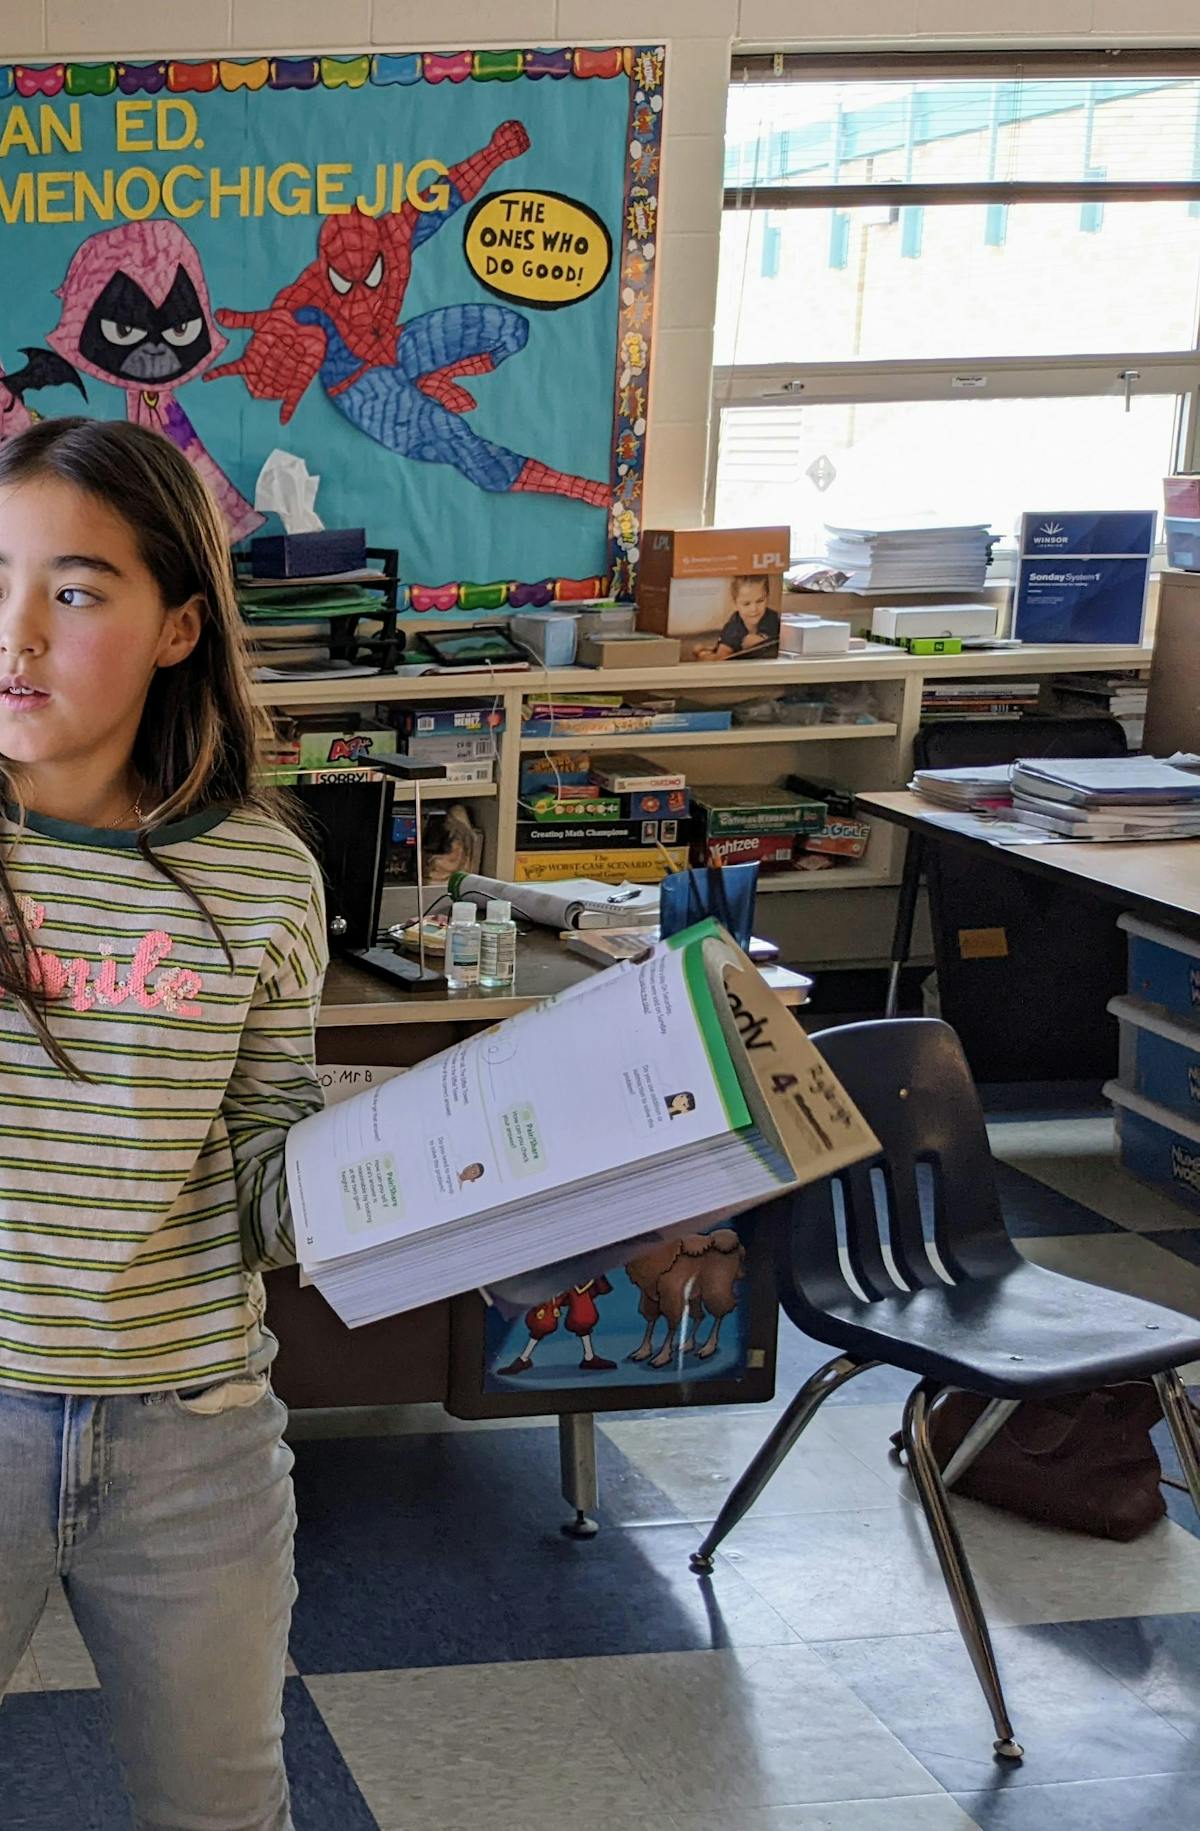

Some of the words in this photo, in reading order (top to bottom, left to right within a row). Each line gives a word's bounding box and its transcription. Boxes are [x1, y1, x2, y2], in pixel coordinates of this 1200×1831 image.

[116, 99, 205, 153] ED.
[500, 200, 545, 223] THE
[480, 227, 535, 250] ONES
[543, 231, 589, 255] WHO
[486, 256, 514, 275] DO
[522, 260, 583, 287] GOOD!
[653, 535, 671, 550] LPL
[752, 553, 785, 569] LPL
[319, 773, 368, 784] SORRY!
[531, 831, 563, 839] Creating
[586, 829, 628, 838] Champions
[822, 821, 872, 838] OGGLE
[709, 837, 760, 857] Yahtzee
[547, 863, 604, 871] WORST-CASE
[607, 861, 652, 869] SCENARIO
[339, 1070, 361, 1083] Mr
[365, 1070, 373, 1082] B
